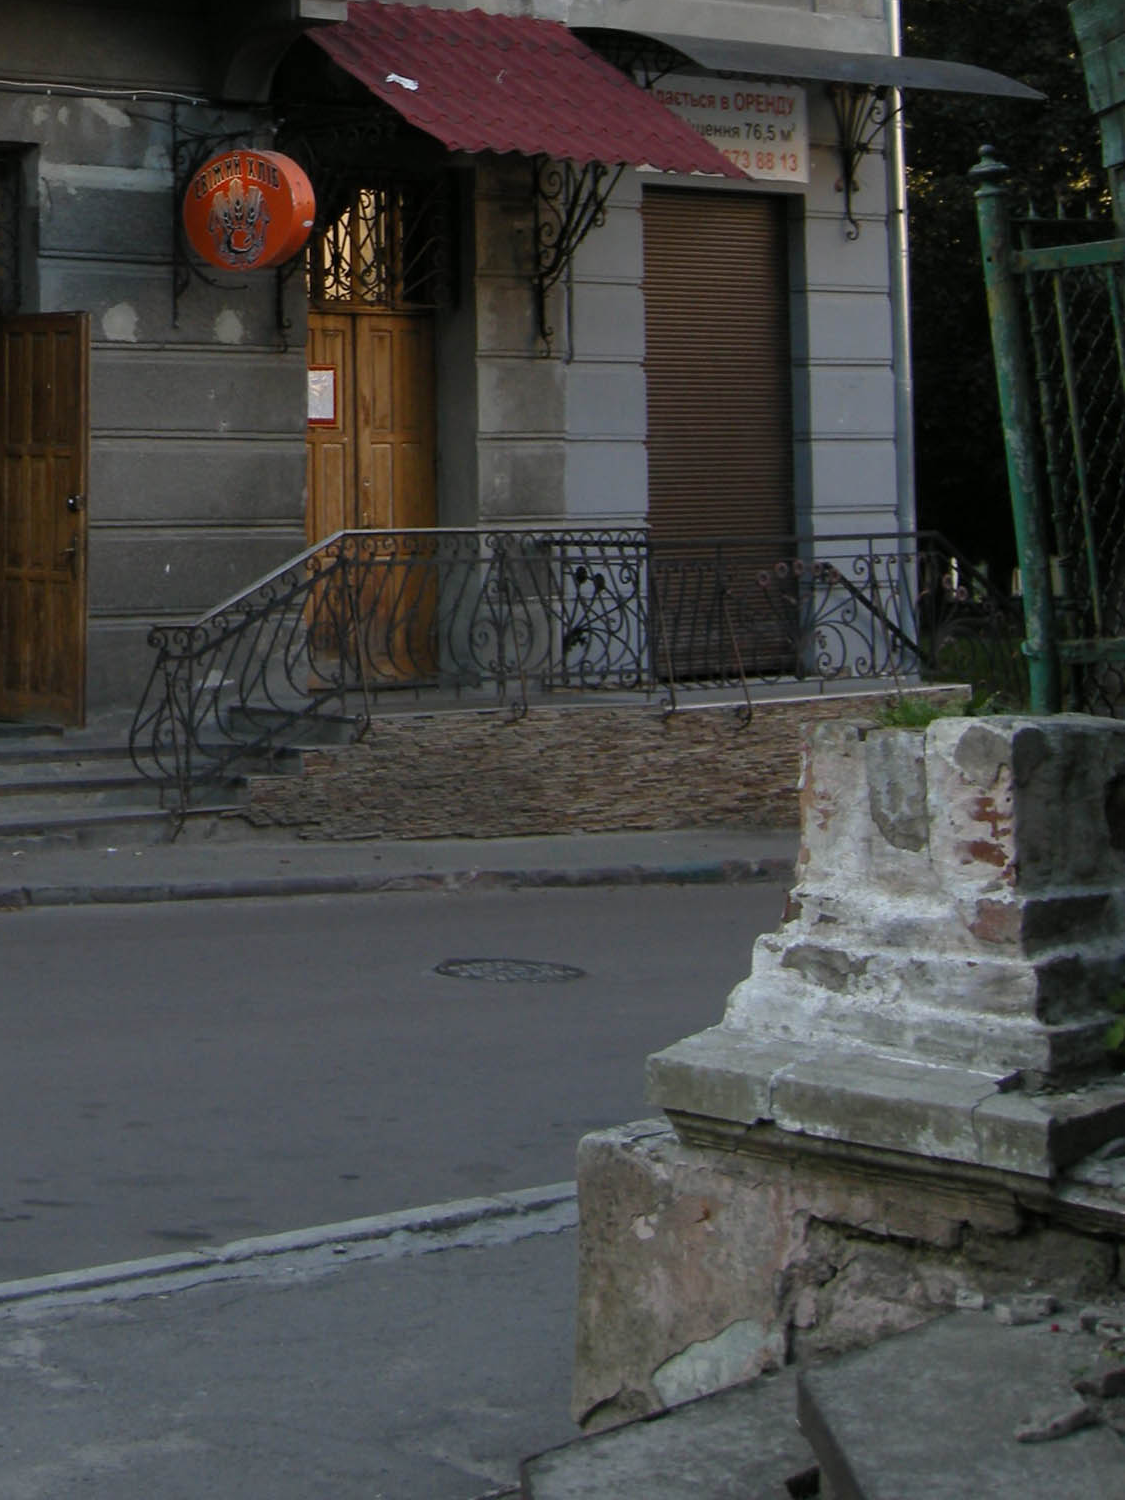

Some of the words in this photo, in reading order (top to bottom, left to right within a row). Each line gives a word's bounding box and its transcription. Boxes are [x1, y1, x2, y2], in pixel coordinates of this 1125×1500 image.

[656, 89, 716, 109] дається
[721, 96, 730, 110] в
[734, 92, 795, 116] ОРЕНДУ
[744, 123, 776, 143] 76,5
[723, 149, 750, 169] 73
[780, 151, 798, 172] 13
[195, 155, 243, 199] СВІЖИЙ
[246, 157, 280, 189] ХЛІБ
